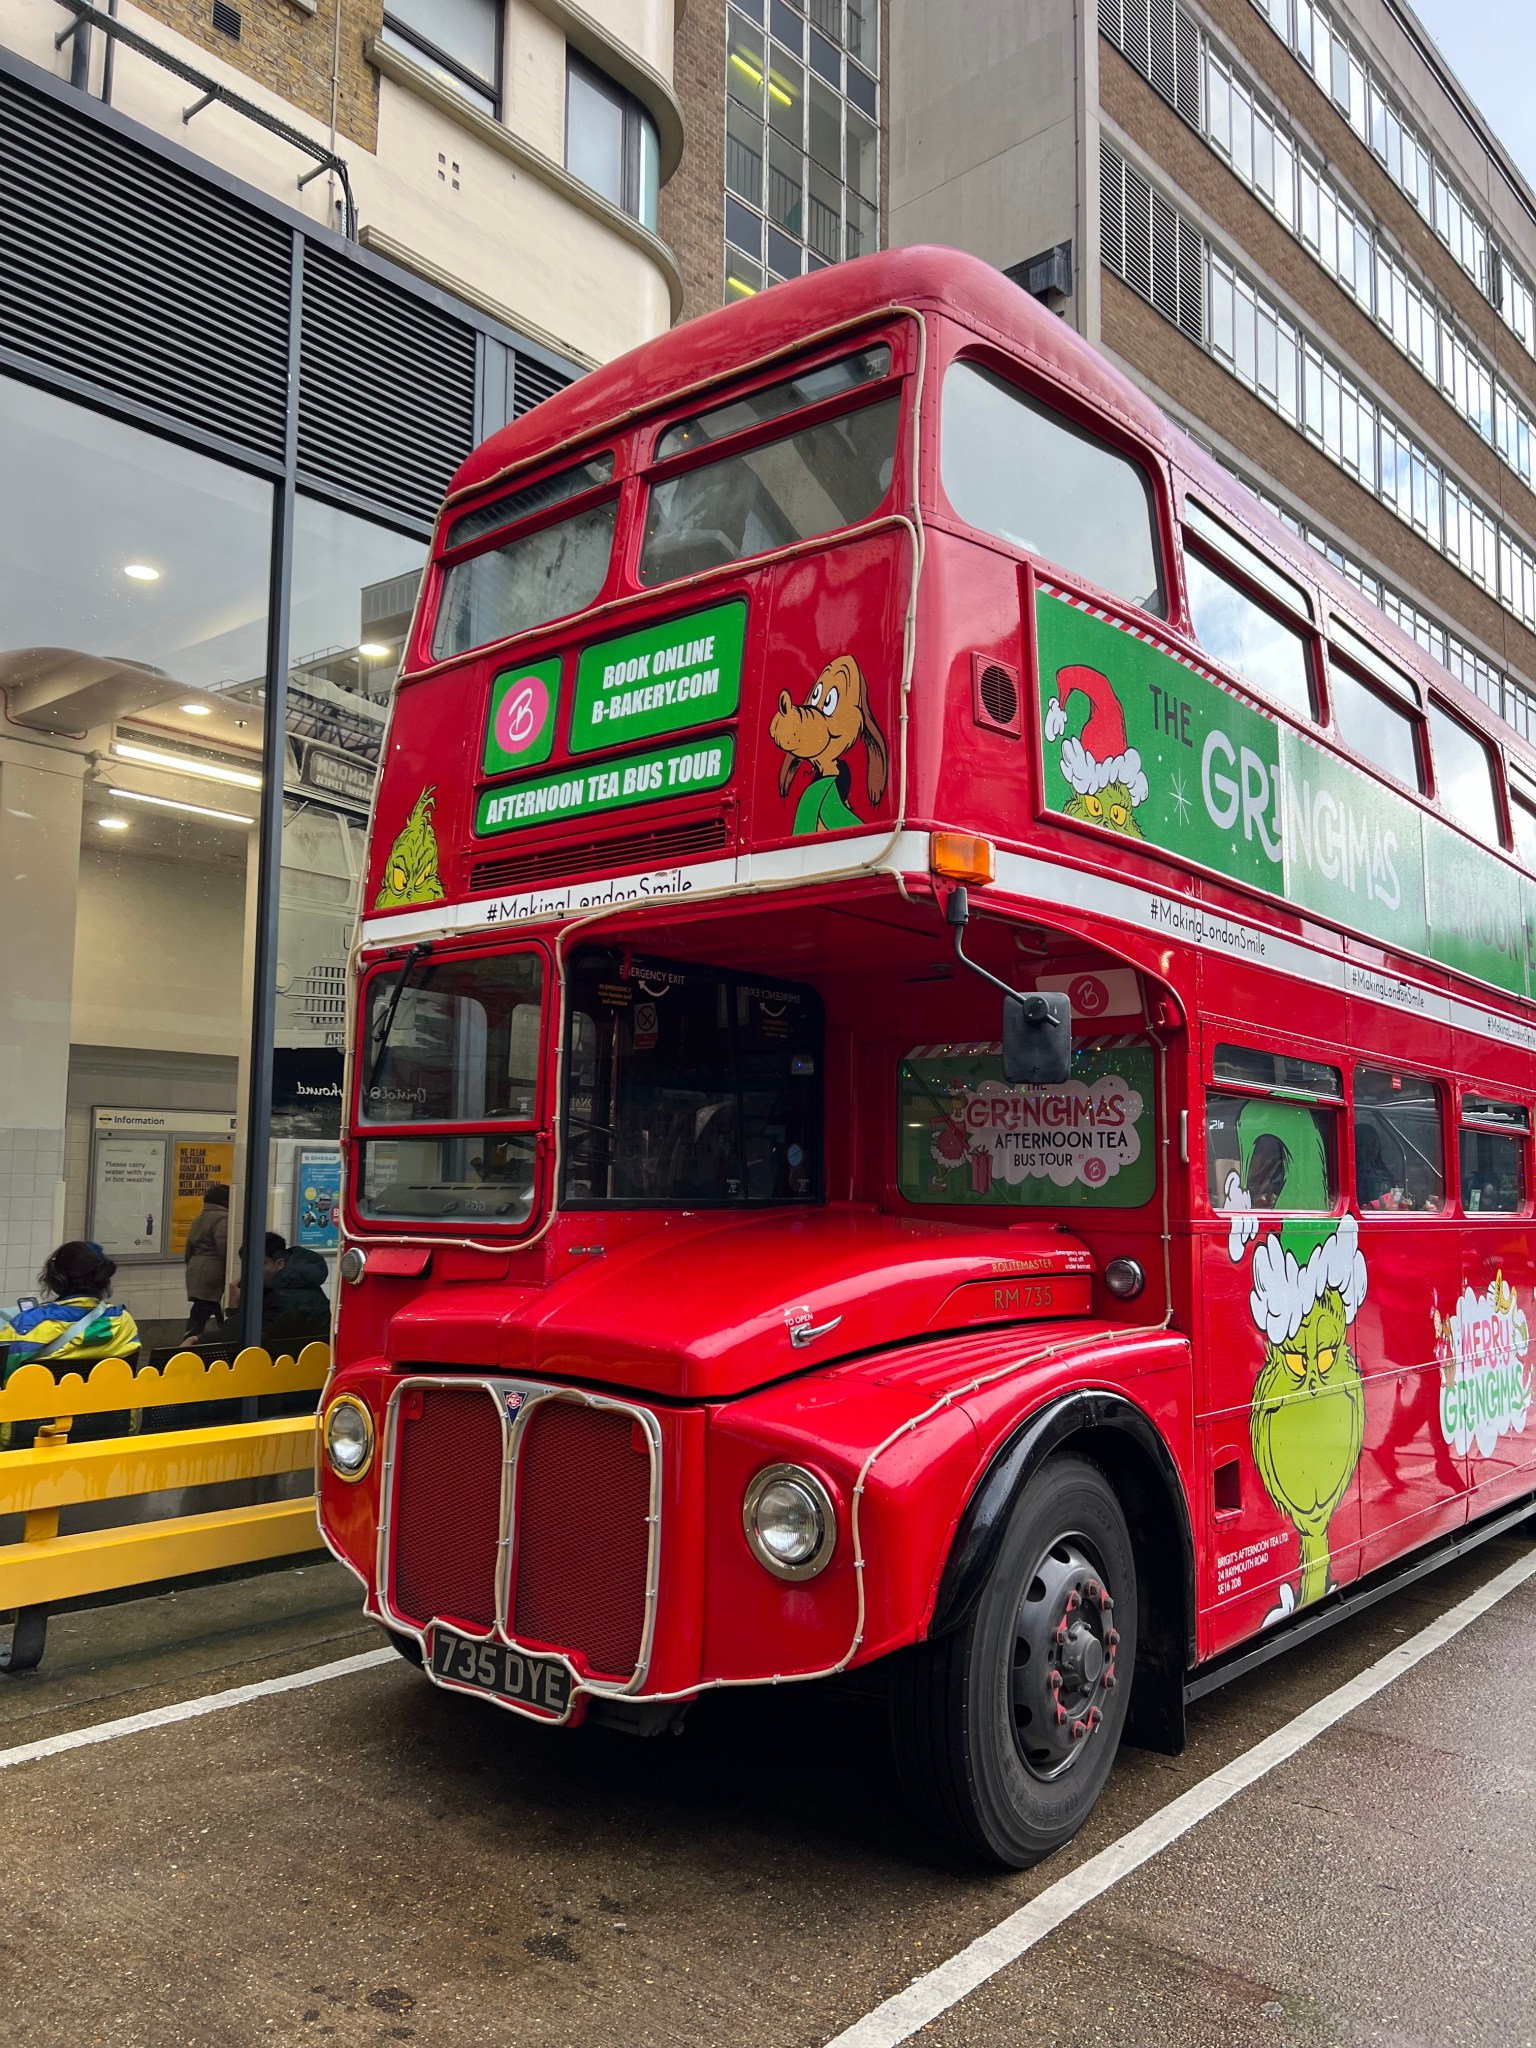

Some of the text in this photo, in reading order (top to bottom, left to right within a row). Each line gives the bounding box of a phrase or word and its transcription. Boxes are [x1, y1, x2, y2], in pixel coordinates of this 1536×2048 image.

[602, 635, 715, 690] BOOK ONLINE
[591, 669, 719, 725] B-BAKERY.COM
[1150, 684, 1193, 748] THE
[485, 748, 721, 824] AFTERNOON TEA BUS TOUR
[1201, 729, 1400, 911] GRINCHMAS
[1150, 898, 1266, 957] #MakingLondonSmile
[619, 965, 685, 985] EERGENCY EXIT
[1351, 962, 1425, 1009] #MakingLondonSmile
[114, 1115, 165, 1125] Information
[967, 1094, 1125, 1130] GRINCHMAS
[995, 1130, 1128, 1150] AFTERNOON TEA
[1014, 1153, 1036, 1167] BUS
[1038, 1153, 1073, 1167] TOUR
[991, 1259, 1053, 1273] ROUTEMASTER
[994, 1286, 1052, 1309] RM 735
[784, 1313, 813, 1327] TO OPEN
[1217, 1552, 1238, 1568] BRIGIT'S
[1238, 1540, 1269, 1558] AFTERNOON
[1269, 1536, 1279, 1547] TEA
[1217, 1553, 1269, 1582] 24 RAYMOUTH ROAD
[1217, 1577, 1242, 1595] SE16 2DB
[440, 1634, 564, 1709] 735 DYE
